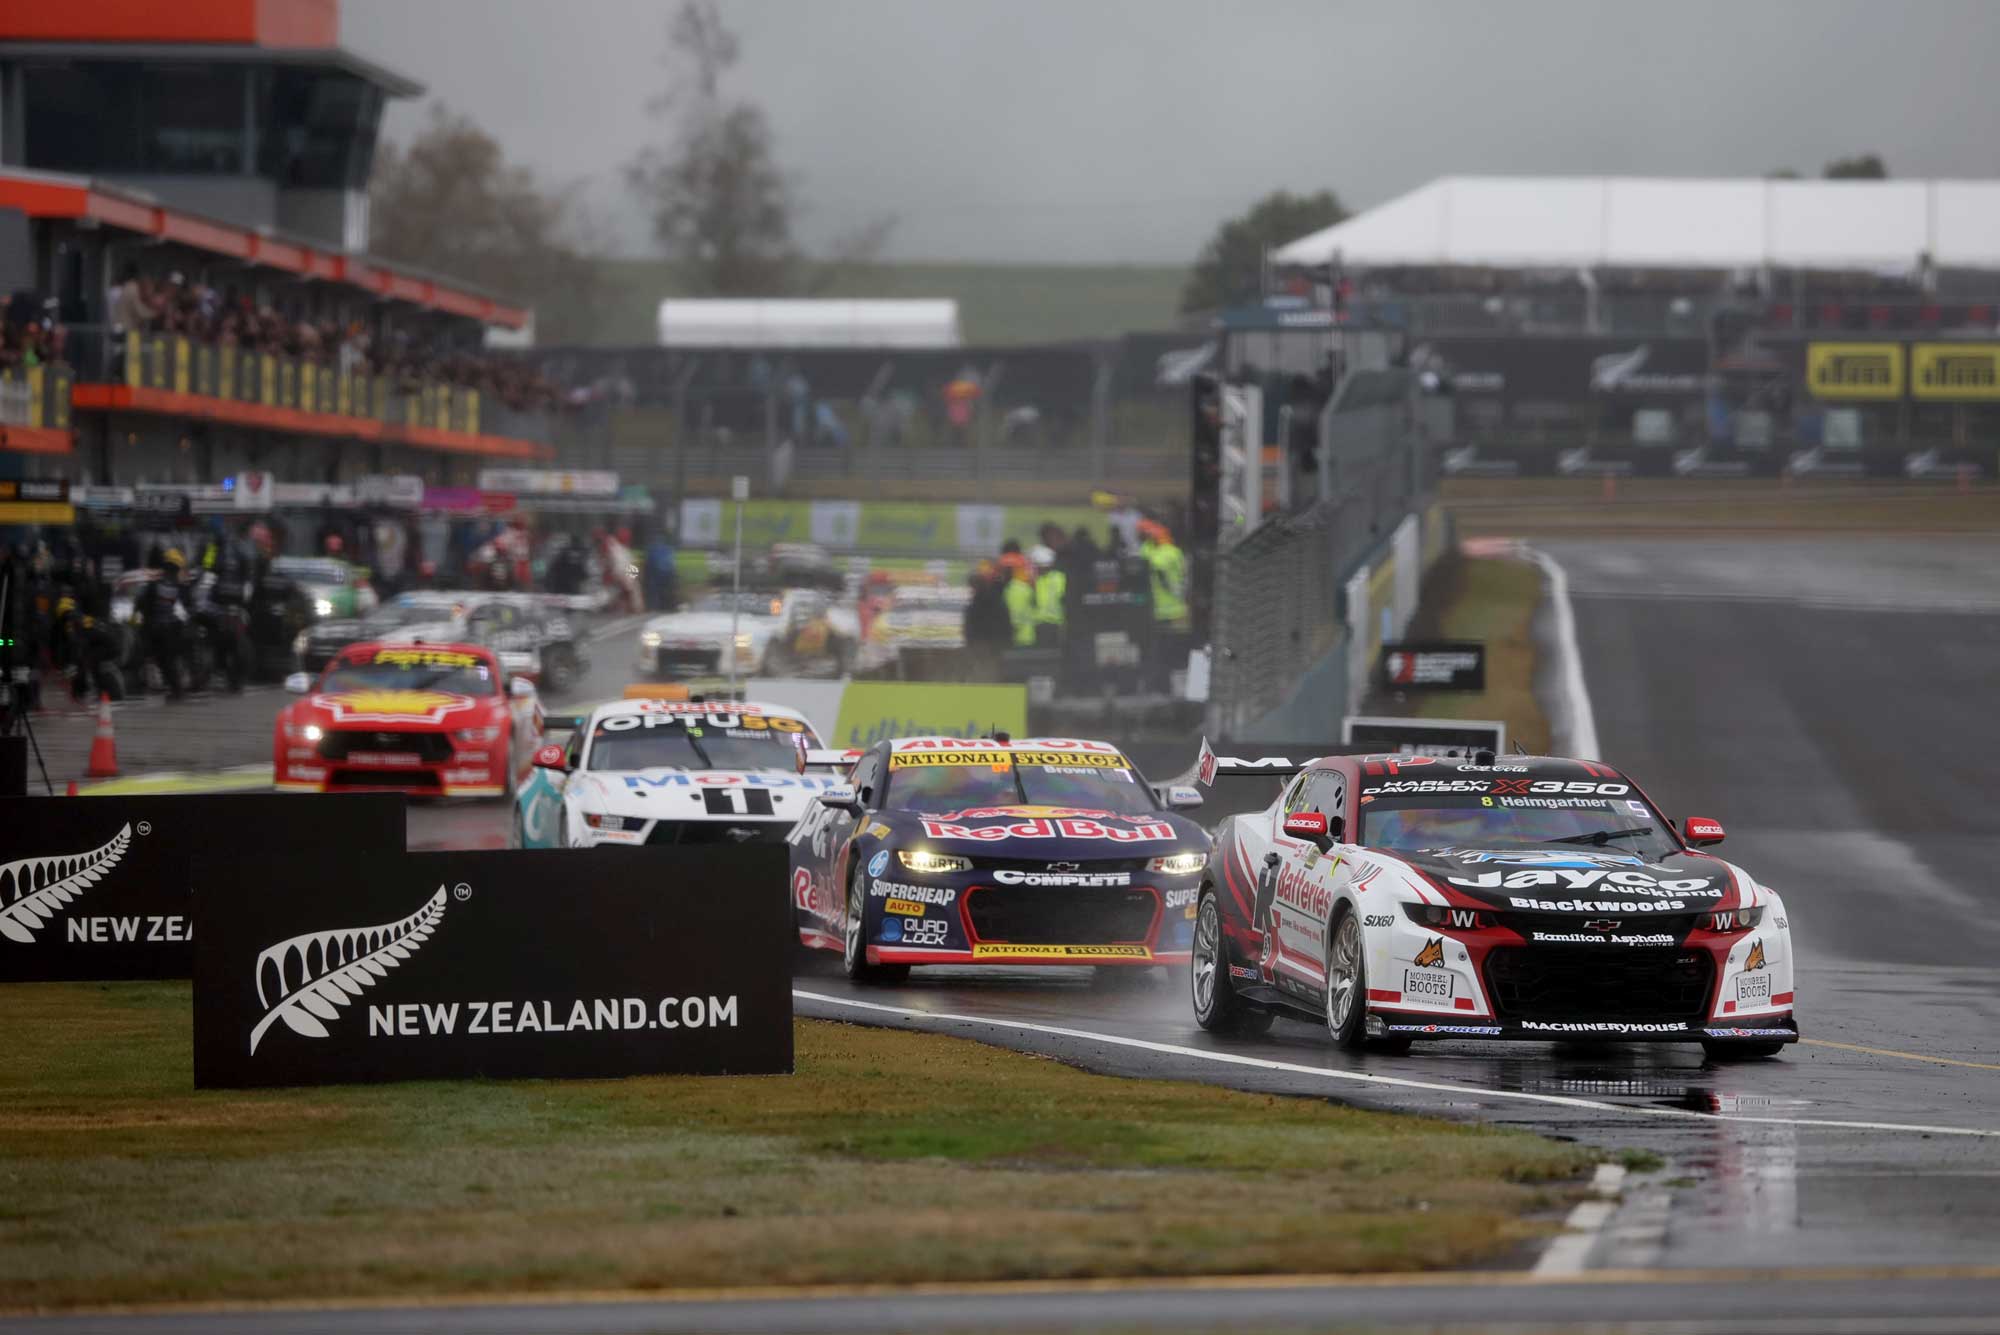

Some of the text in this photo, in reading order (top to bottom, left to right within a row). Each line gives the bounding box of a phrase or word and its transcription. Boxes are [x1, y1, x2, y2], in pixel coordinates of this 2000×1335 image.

[893, 752, 1122, 767] NATIONAL STORAGE
[1044, 765, 1098, 775] Brown
[1362, 786, 1488, 795] DAVIDSON
[1383, 780, 1491, 788] HARLEY-
[721, 789, 748, 813] 1
[1481, 796, 1607, 809] 8 Heimgartner
[921, 818, 1177, 842] Red Bull
[993, 870, 1130, 887] COMPLETE
[1447, 870, 1710, 891] Jayco
[870, 879, 956, 906] SUPERCHEAP
[1276, 861, 1333, 919] Batteries
[1600, 883, 1724, 898] Auckland
[889, 903, 921, 913] AUTO
[1509, 897, 1686, 912] Blackwoods
[904, 918, 948, 933] QUAD
[1363, 913, 1395, 928] SIX60
[67, 917, 139, 942] NEW
[902, 932, 947, 945] LOCK
[1532, 932, 1675, 947] Hamilton Asphalts
[1067, 945, 1145, 956] STORAGE
[1409, 972, 1448, 984] MONGREL
[1409, 980, 1447, 996] BOOTS
[1740, 984, 1767, 999] BOOTS
[369, 997, 738, 1036] NEW ZEALAND.COM
[1521, 1020, 1689, 1033] MACHINERYHOUSE
